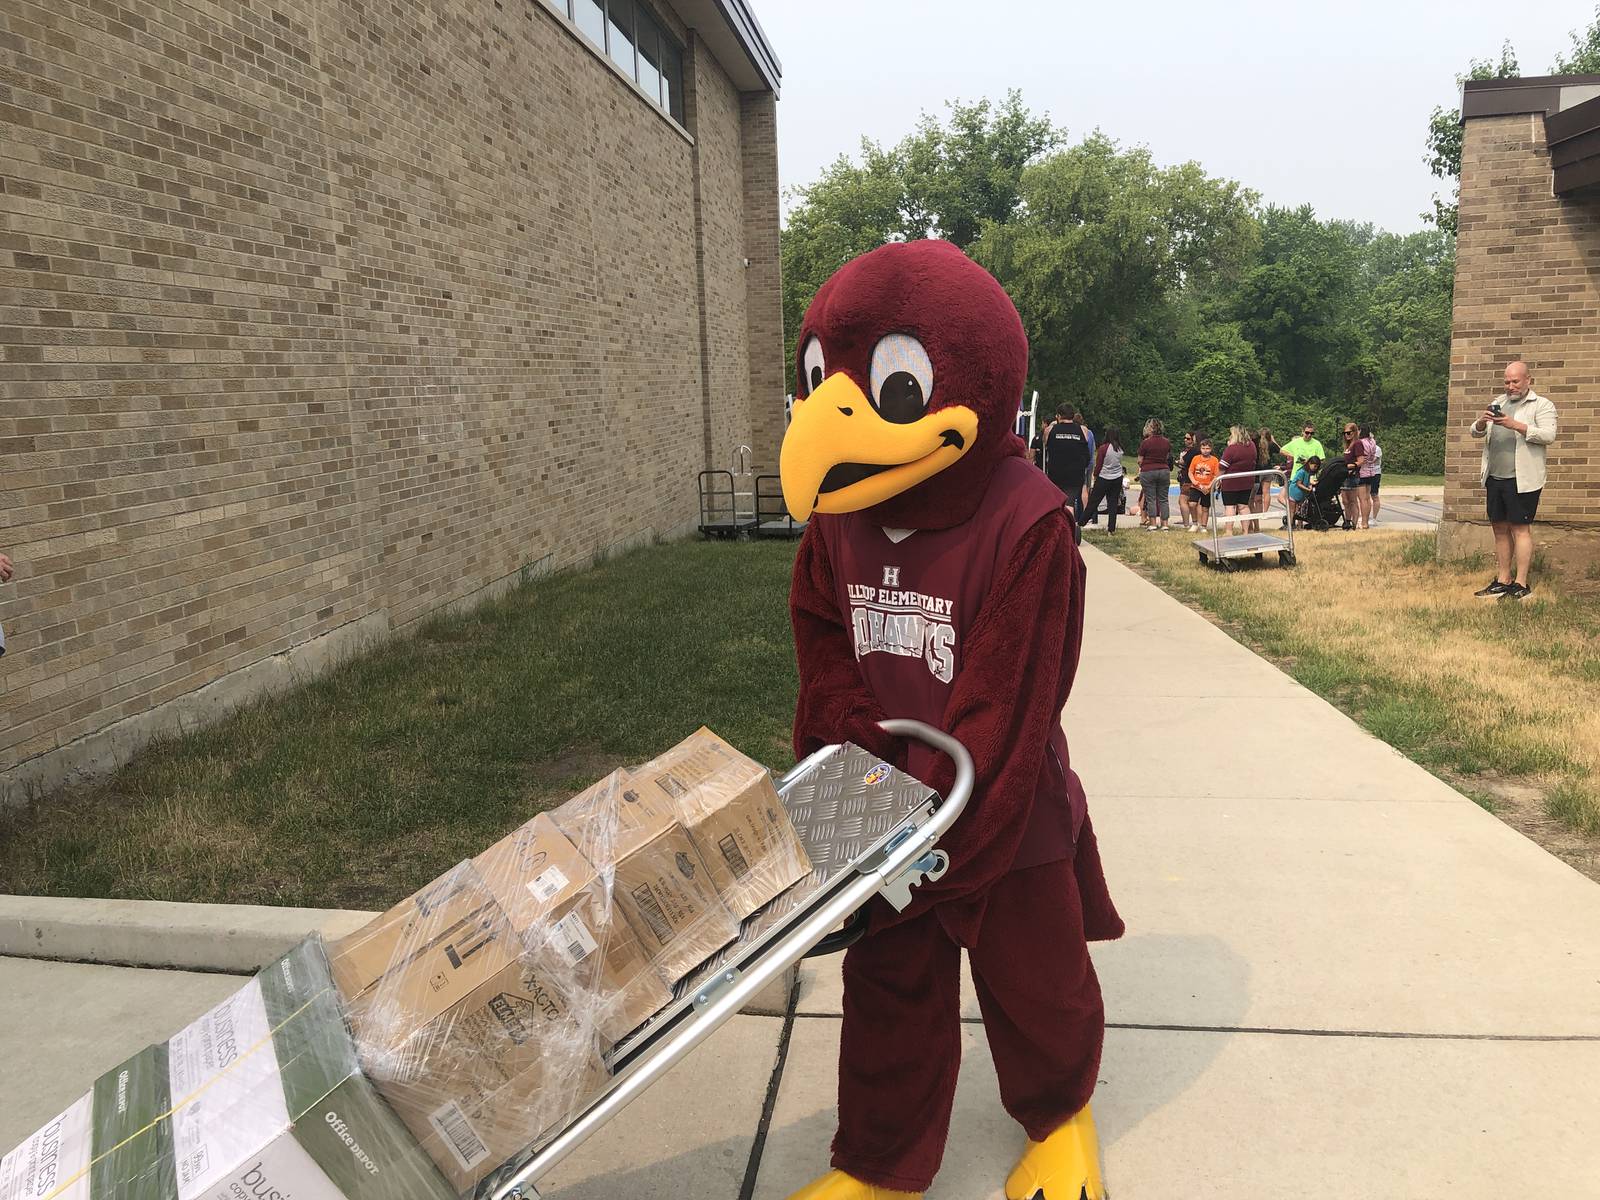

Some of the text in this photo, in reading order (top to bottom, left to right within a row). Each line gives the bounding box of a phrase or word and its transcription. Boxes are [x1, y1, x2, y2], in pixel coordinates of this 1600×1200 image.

[847, 583, 953, 614] ILLTOP ELEMENTARY
[882, 565, 900, 587] H
[37, 1114, 68, 1196] business
[325, 1111, 380, 1174] Office DEPOT
